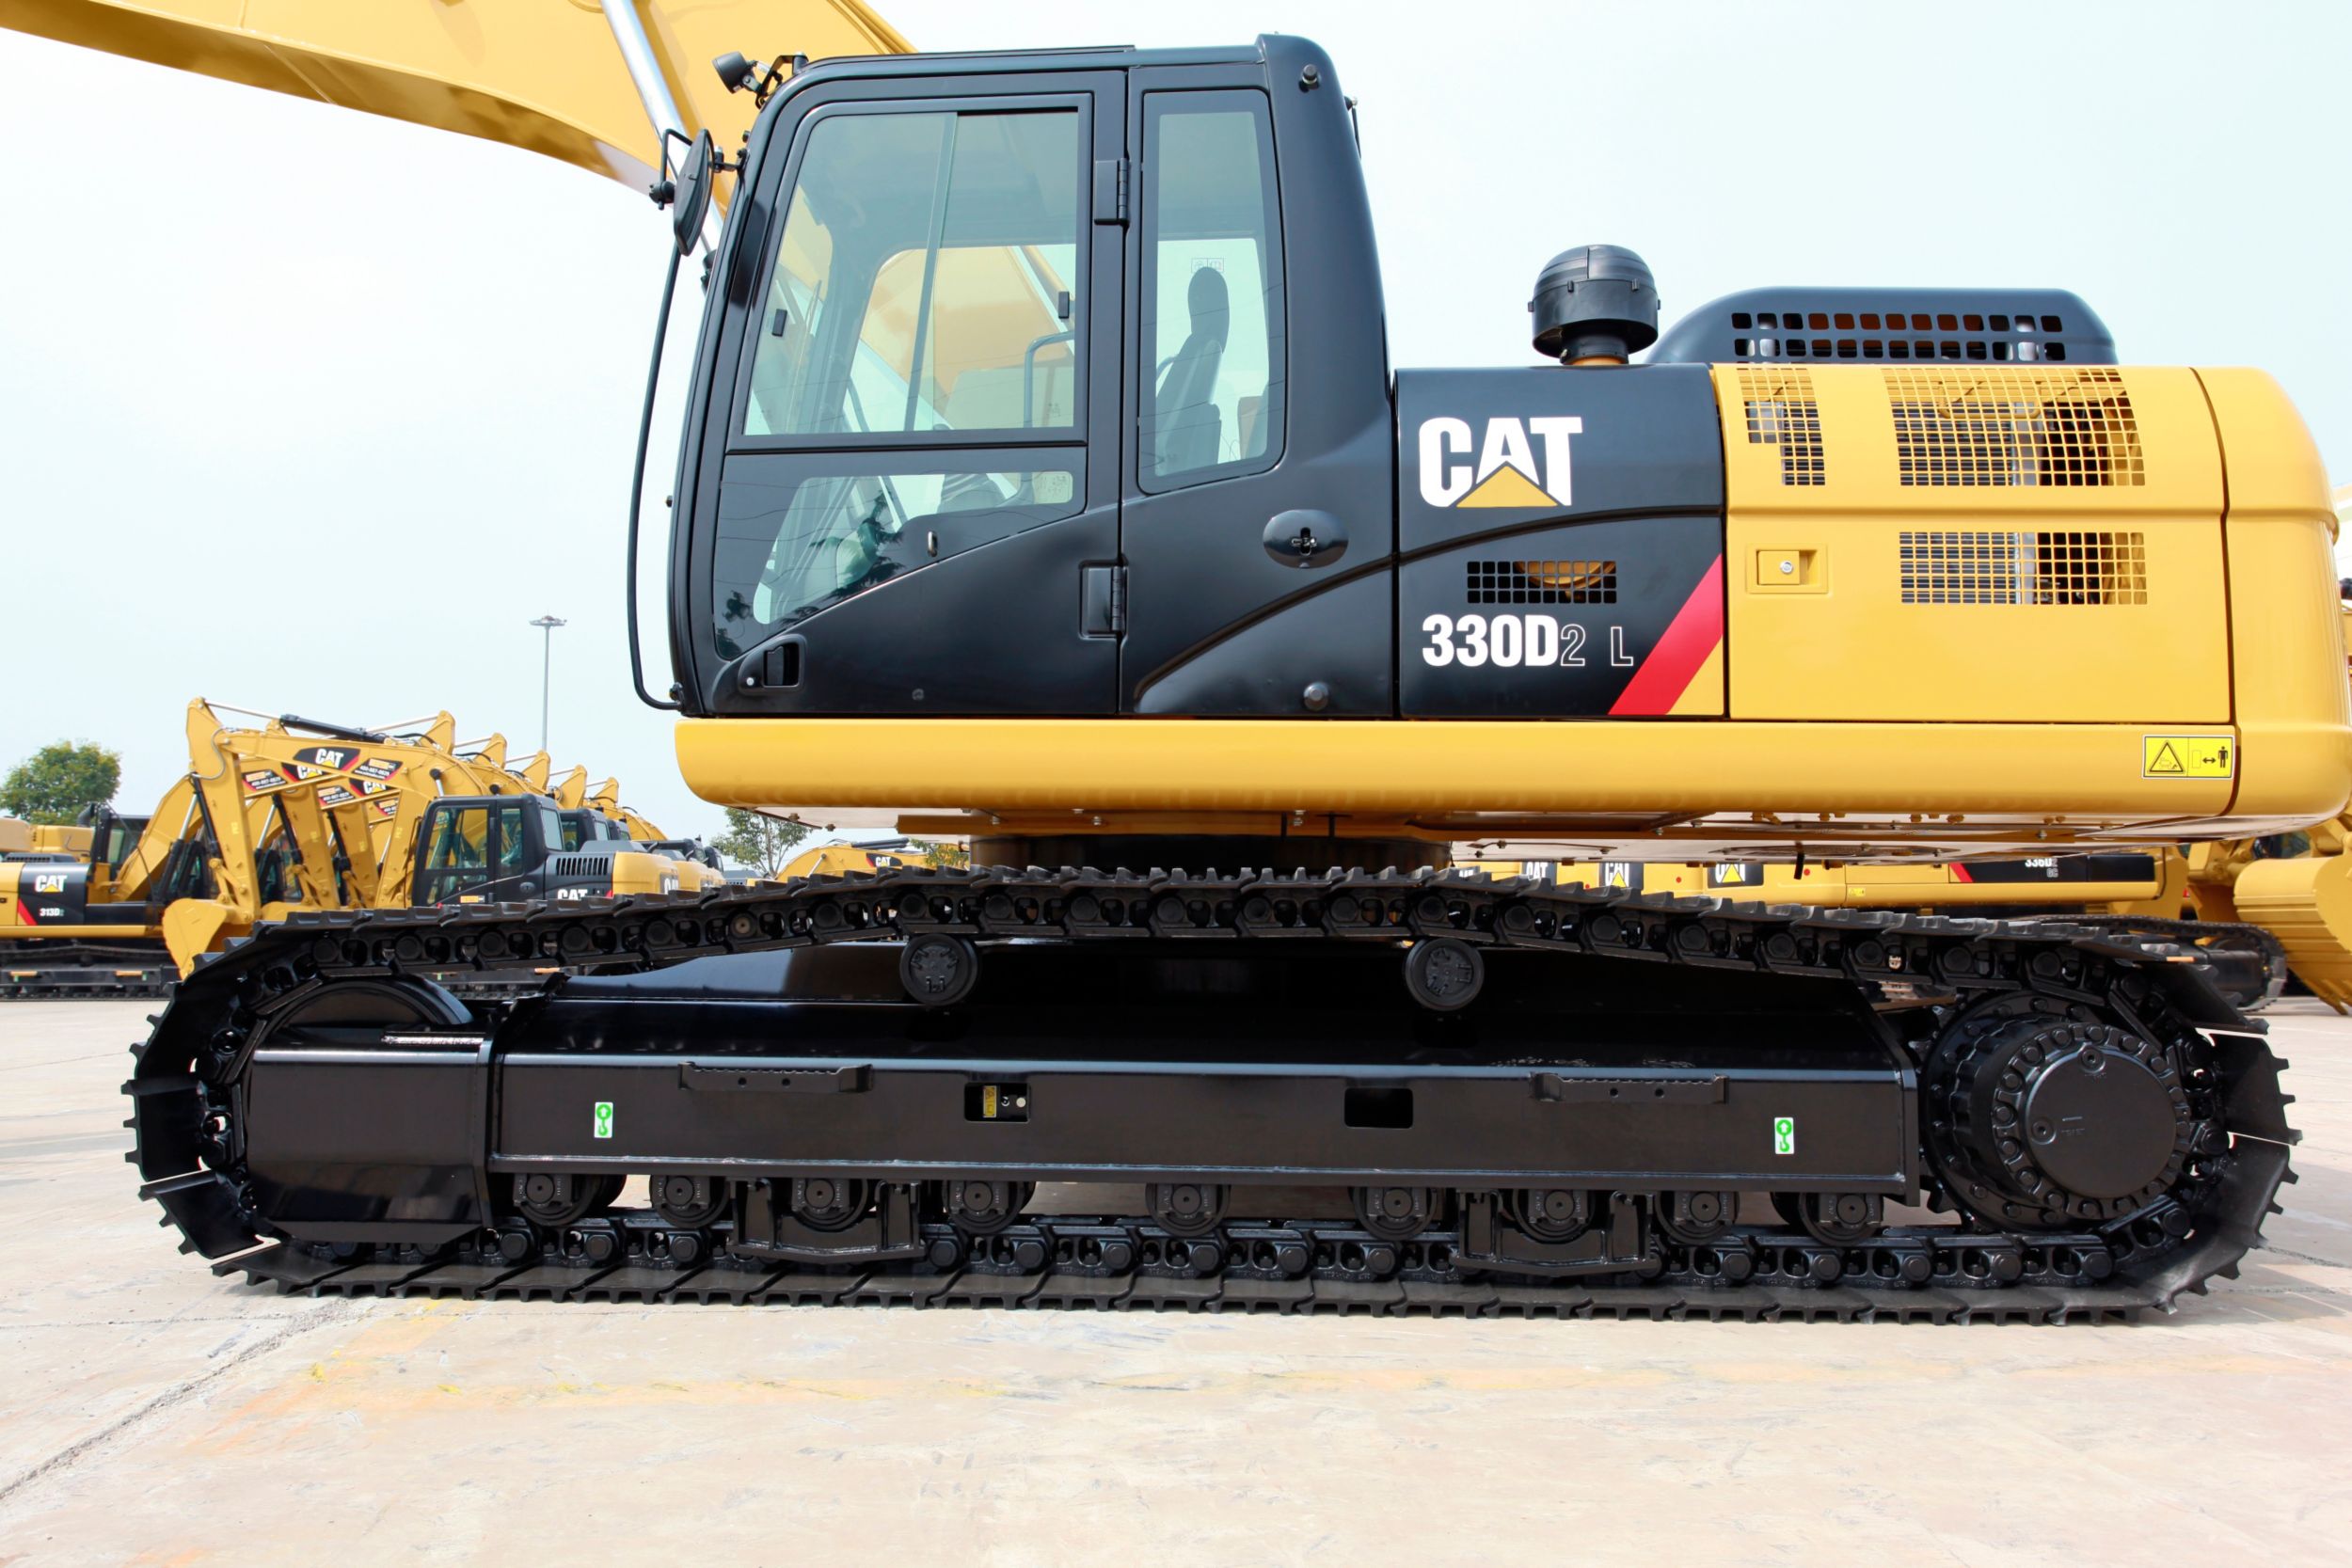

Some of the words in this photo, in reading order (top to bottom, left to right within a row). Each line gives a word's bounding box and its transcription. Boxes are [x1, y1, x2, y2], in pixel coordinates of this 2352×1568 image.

[1419, 417, 1583, 508] CAT
[1422, 613, 1586, 668] 330D2
[1610, 626, 1634, 667] L
[315, 748, 344, 768] CAT
[876, 856, 891, 867] CAT
[2046, 867, 2058, 878] GC
[35, 875, 68, 893] CAT
